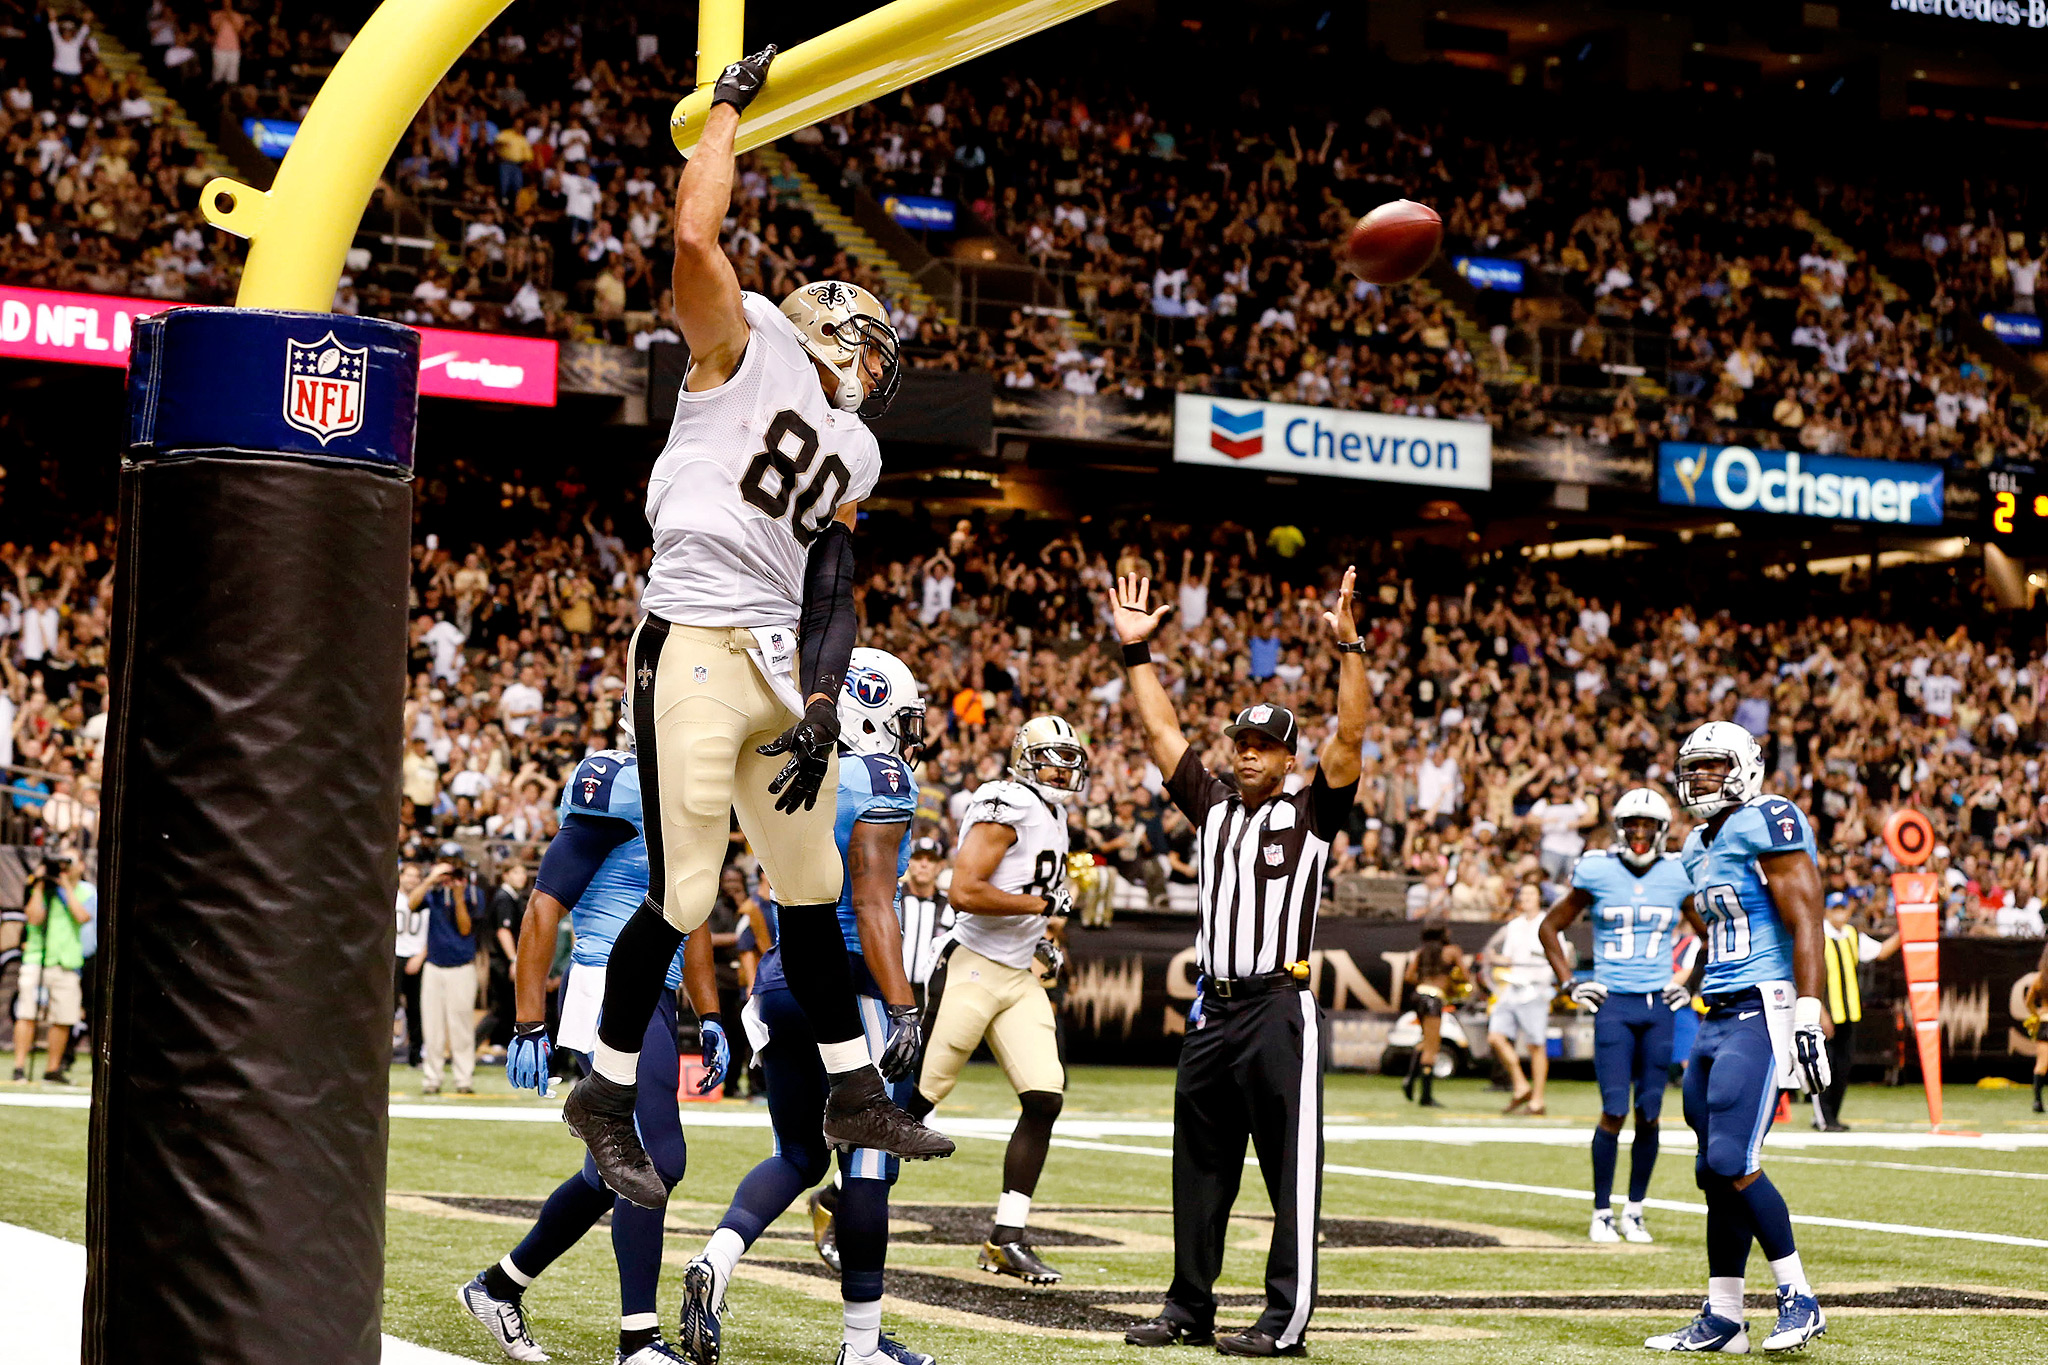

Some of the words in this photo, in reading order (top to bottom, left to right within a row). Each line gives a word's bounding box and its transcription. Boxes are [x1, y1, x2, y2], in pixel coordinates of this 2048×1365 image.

[36, 303, 109, 350] NFL
[295, 379, 354, 428] NFL
[1285, 418, 1459, 470] Chevron
[739, 409, 851, 550] 80
[1711, 446, 1920, 523] Ochsner
[1994, 491, 2015, 533] 2
[1603, 905, 1673, 960] 37
